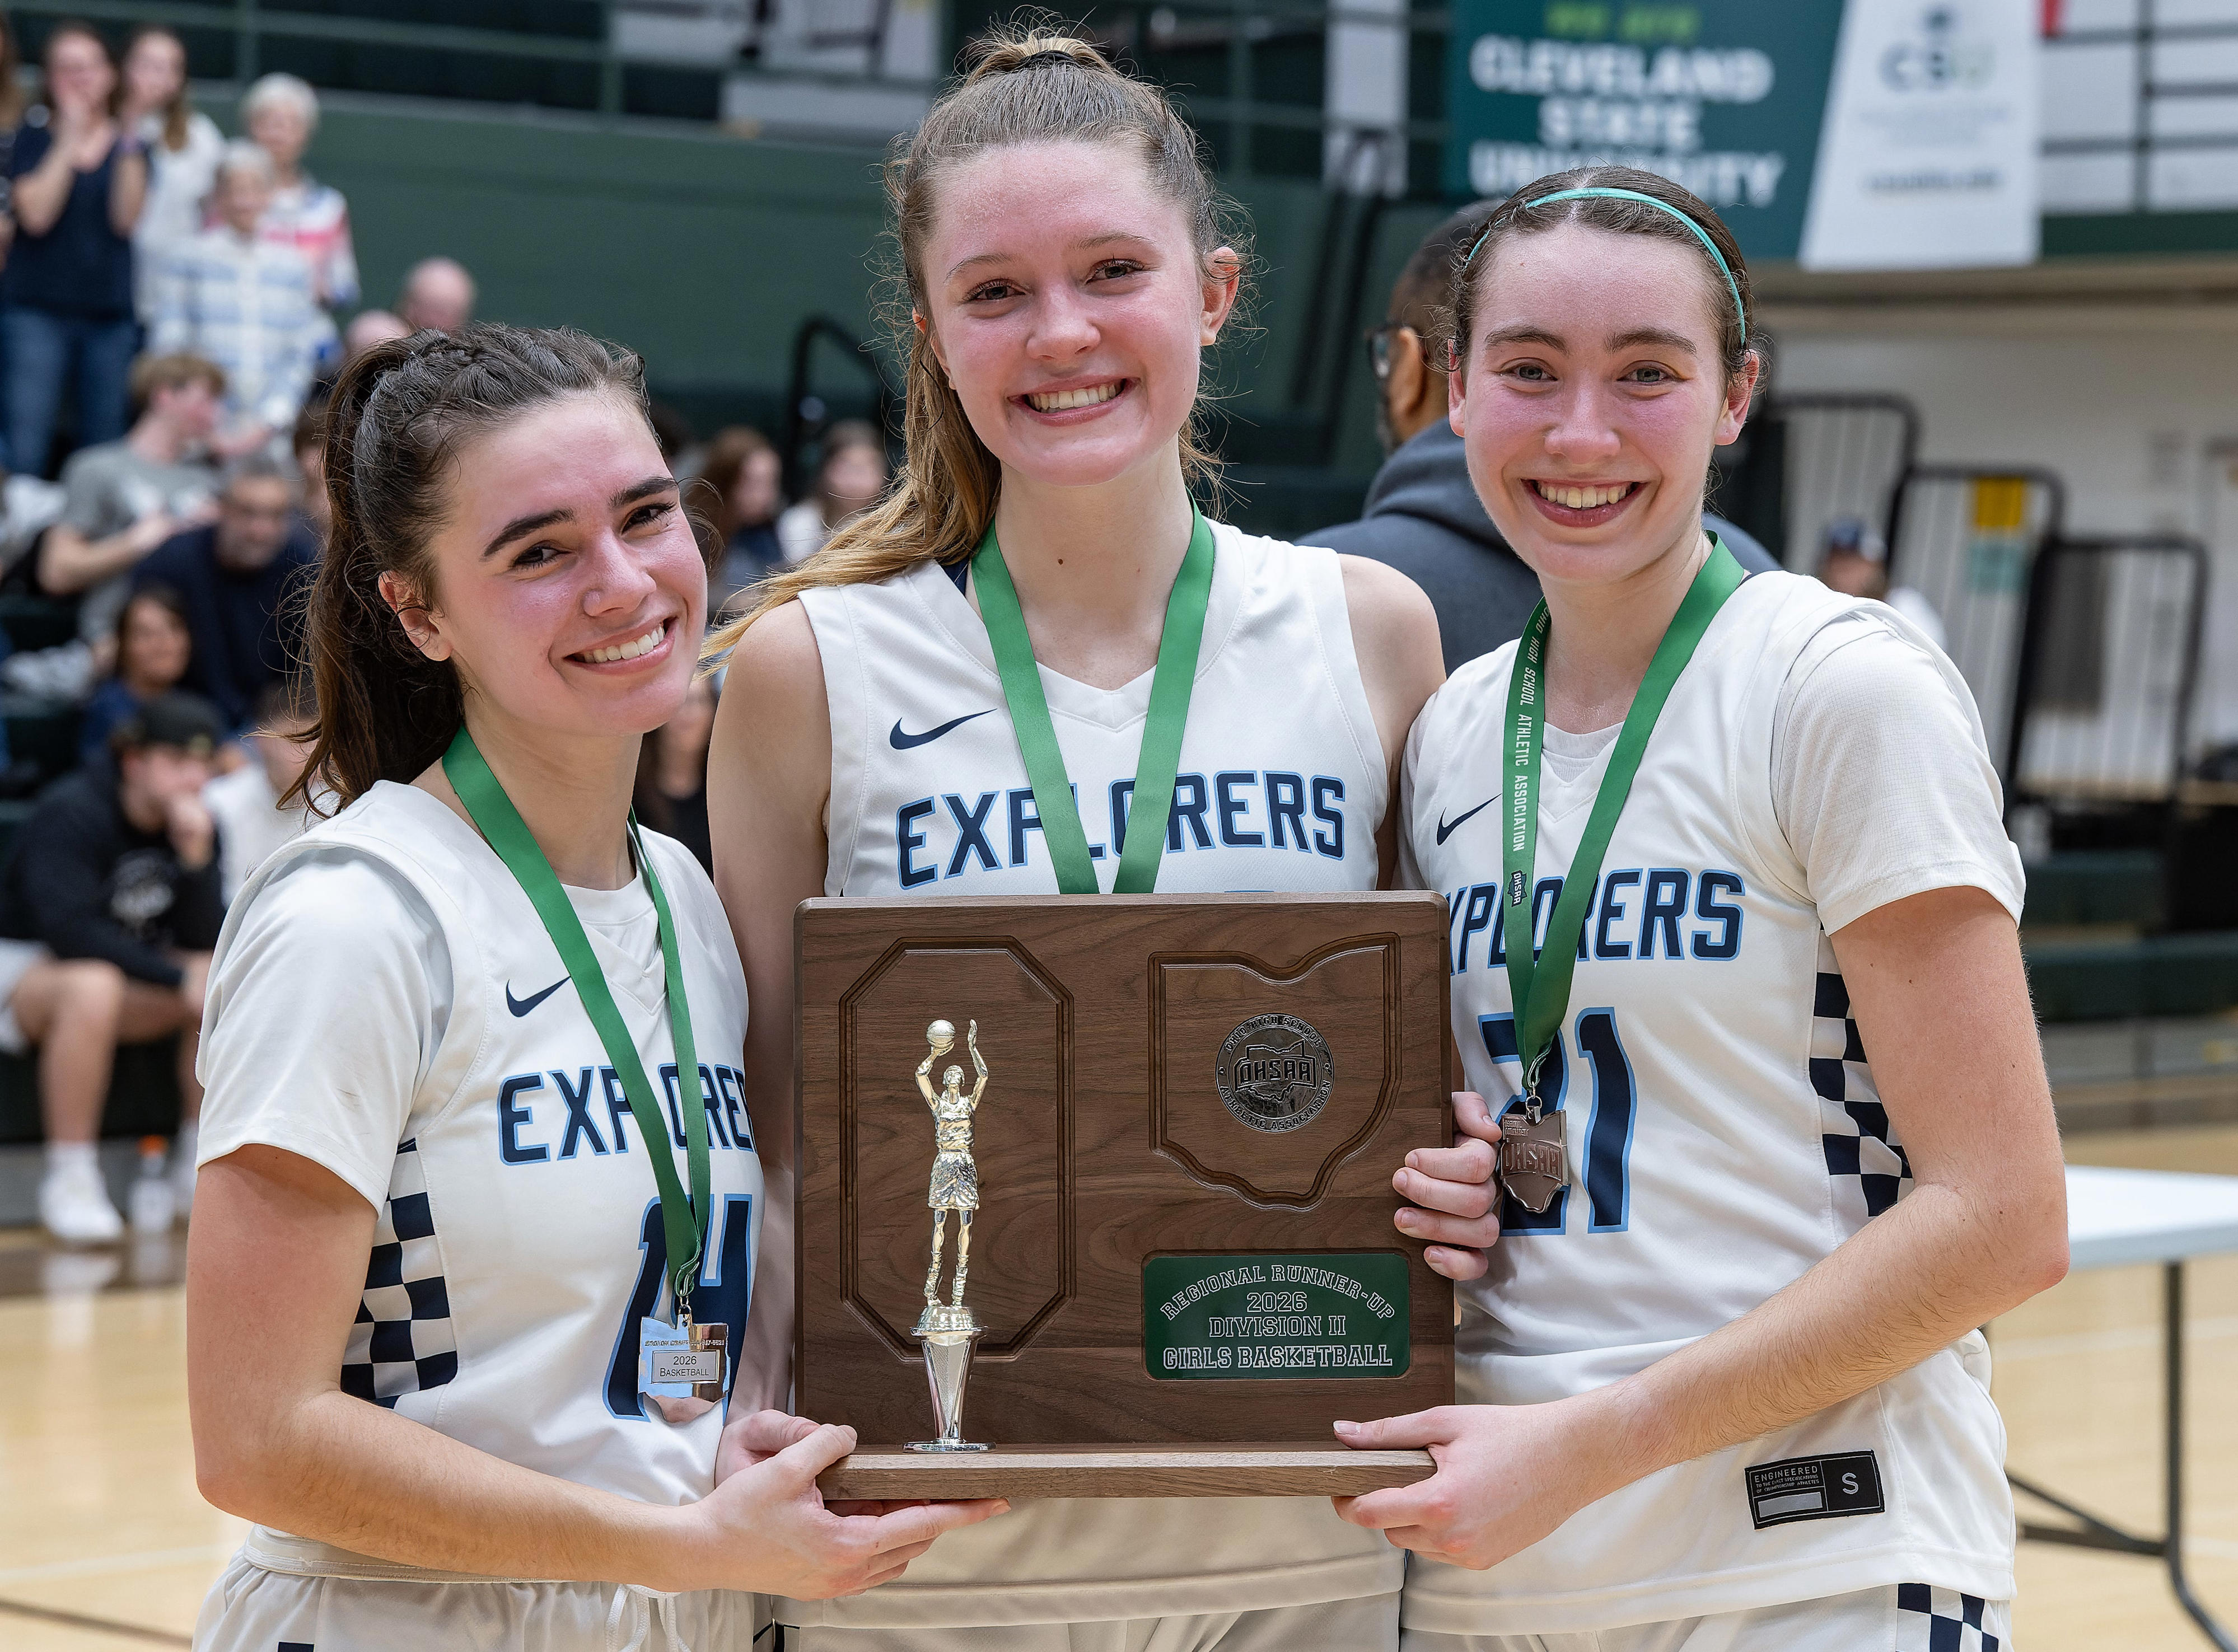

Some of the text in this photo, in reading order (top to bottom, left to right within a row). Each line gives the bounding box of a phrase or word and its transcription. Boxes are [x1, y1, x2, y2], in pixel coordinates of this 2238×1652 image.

[1470, 35, 1774, 104] CLEVELAND
[1539, 96, 1700, 152] STATE
[1527, 636, 1540, 664] HIGH
[1520, 667, 1536, 706] SCHOOL
[1515, 714, 1533, 766] ATHLETIC
[1513, 775, 1528, 851] ASSOCIATION
[1513, 872, 1522, 905] OHSAA
[1225, 1015, 1323, 1052] OHIO HIGH SCHOOL
[1240, 1060, 1311, 1085] OHSAA
[1220, 1079, 1331, 1130] ATHLETIC ASSOCIATION
[1478, 1007, 1637, 1236] 21
[602, 1193, 753, 1423] 14
[1160, 1264, 1395, 1321] REGIONAL RUNNER-UP
[1246, 1291, 1308, 1313] 2026
[1209, 1315, 1346, 1338] DIVISION II
[660, 1368, 709, 1377] BASKETBALL
[673, 1355, 697, 1365] 2026
[1163, 1345, 1393, 1370] GIRLS BASKETBALL
[1754, 1466, 1818, 1483] ENGINEERED
[1842, 1472, 1859, 1495] S
